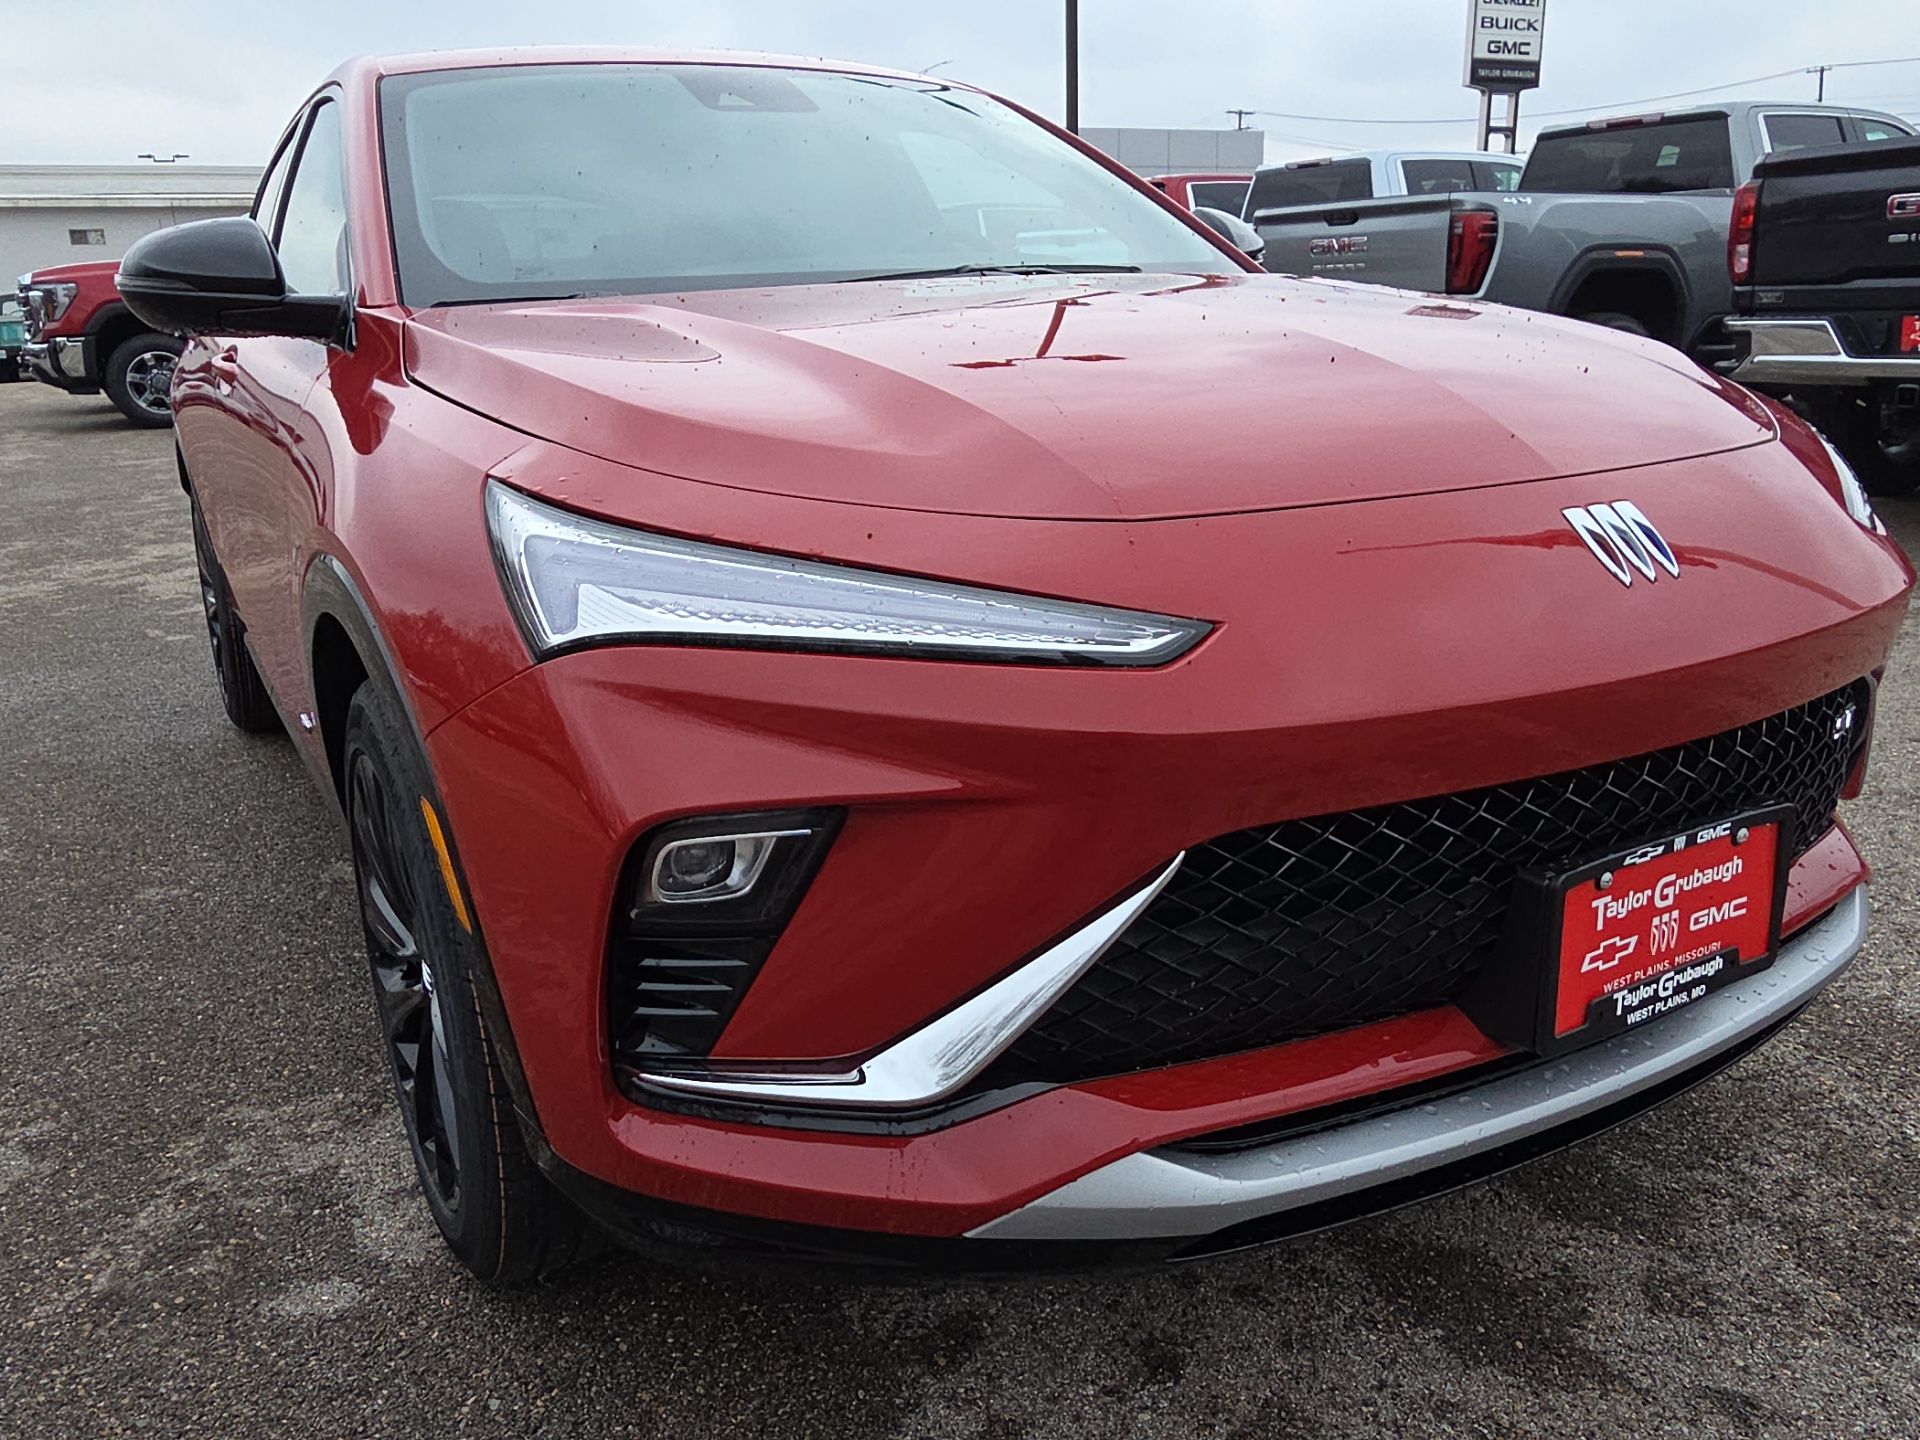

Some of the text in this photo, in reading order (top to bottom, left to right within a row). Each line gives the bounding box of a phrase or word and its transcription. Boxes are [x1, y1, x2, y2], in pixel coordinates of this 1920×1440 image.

[1480, 16, 1539, 32] BUICK
[1487, 40, 1531, 55] GMC
[1478, 68, 1500, 78] TAYLOR
[1309, 236, 1368, 257] GMC
[1697, 822, 1732, 844] GMC
[1591, 856, 1743, 931] Taylor Grubaugh
[1689, 896, 1748, 931] GMC
[1603, 974, 1632, 994] WEST
[1674, 941, 1721, 967] MISSOURI
[1612, 955, 1724, 1016] Taylor Grubaugh
[1626, 984, 1706, 1025] WEST PLAINS, MO
